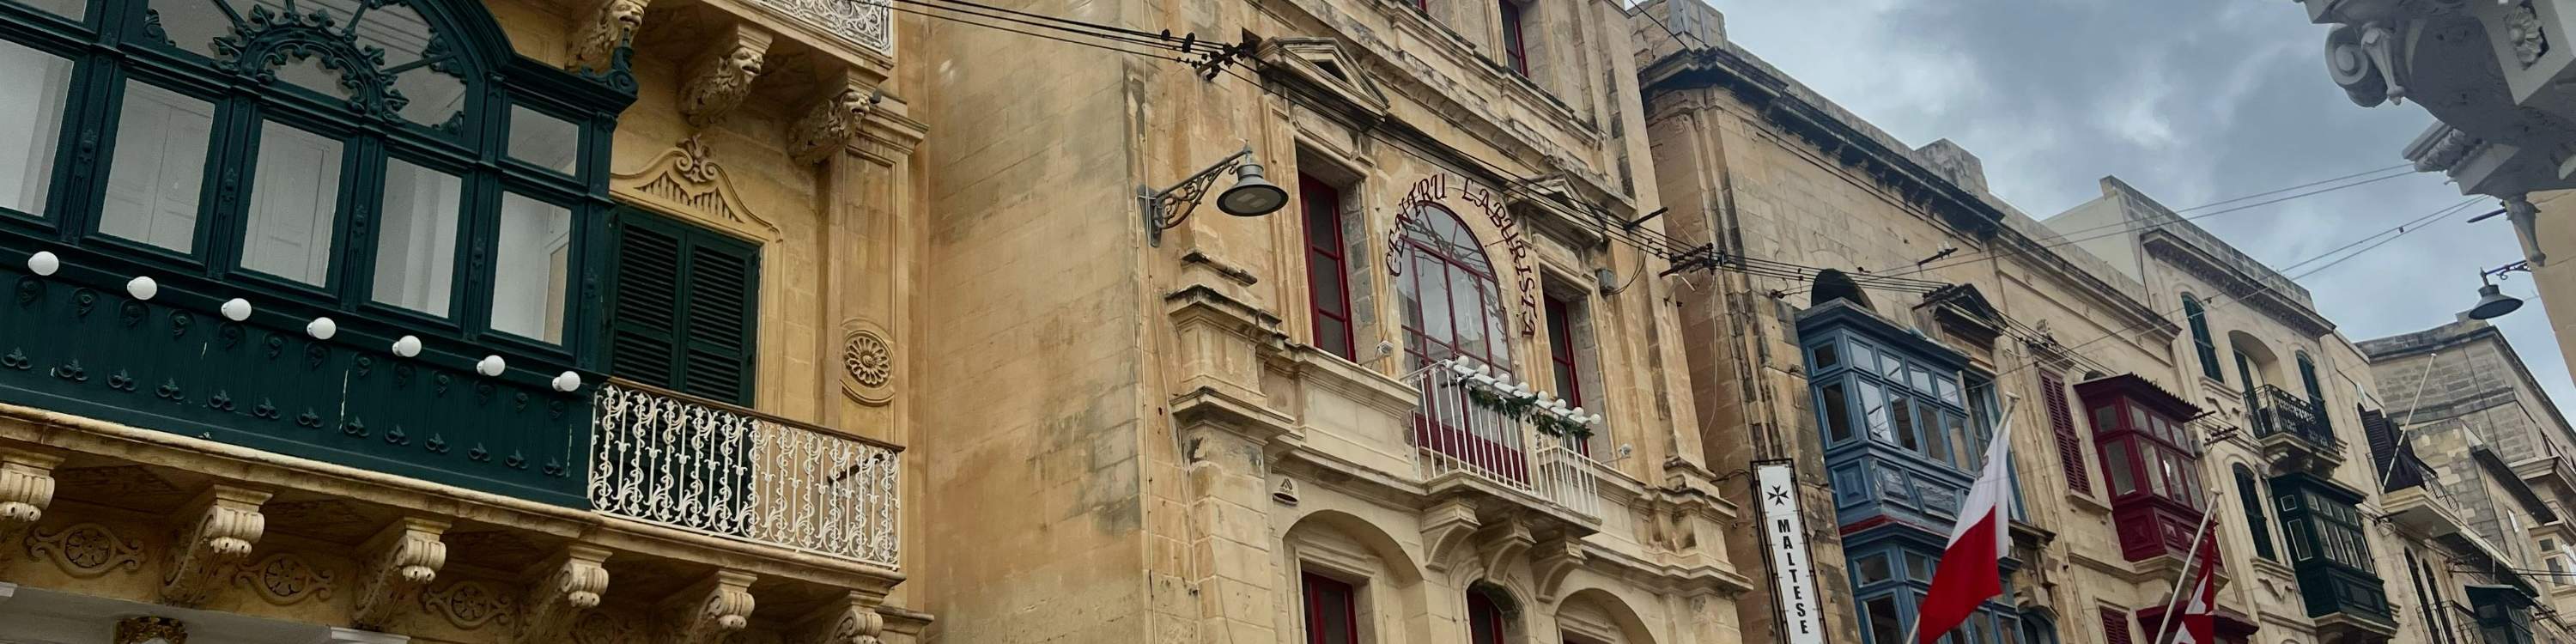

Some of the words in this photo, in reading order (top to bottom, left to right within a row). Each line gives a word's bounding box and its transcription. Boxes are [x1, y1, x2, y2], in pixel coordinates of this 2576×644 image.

[1386, 173, 1447, 277] CENTRU
[1461, 177, 1538, 339] LABURISTA
[1777, 519, 1809, 635] MALTESE
